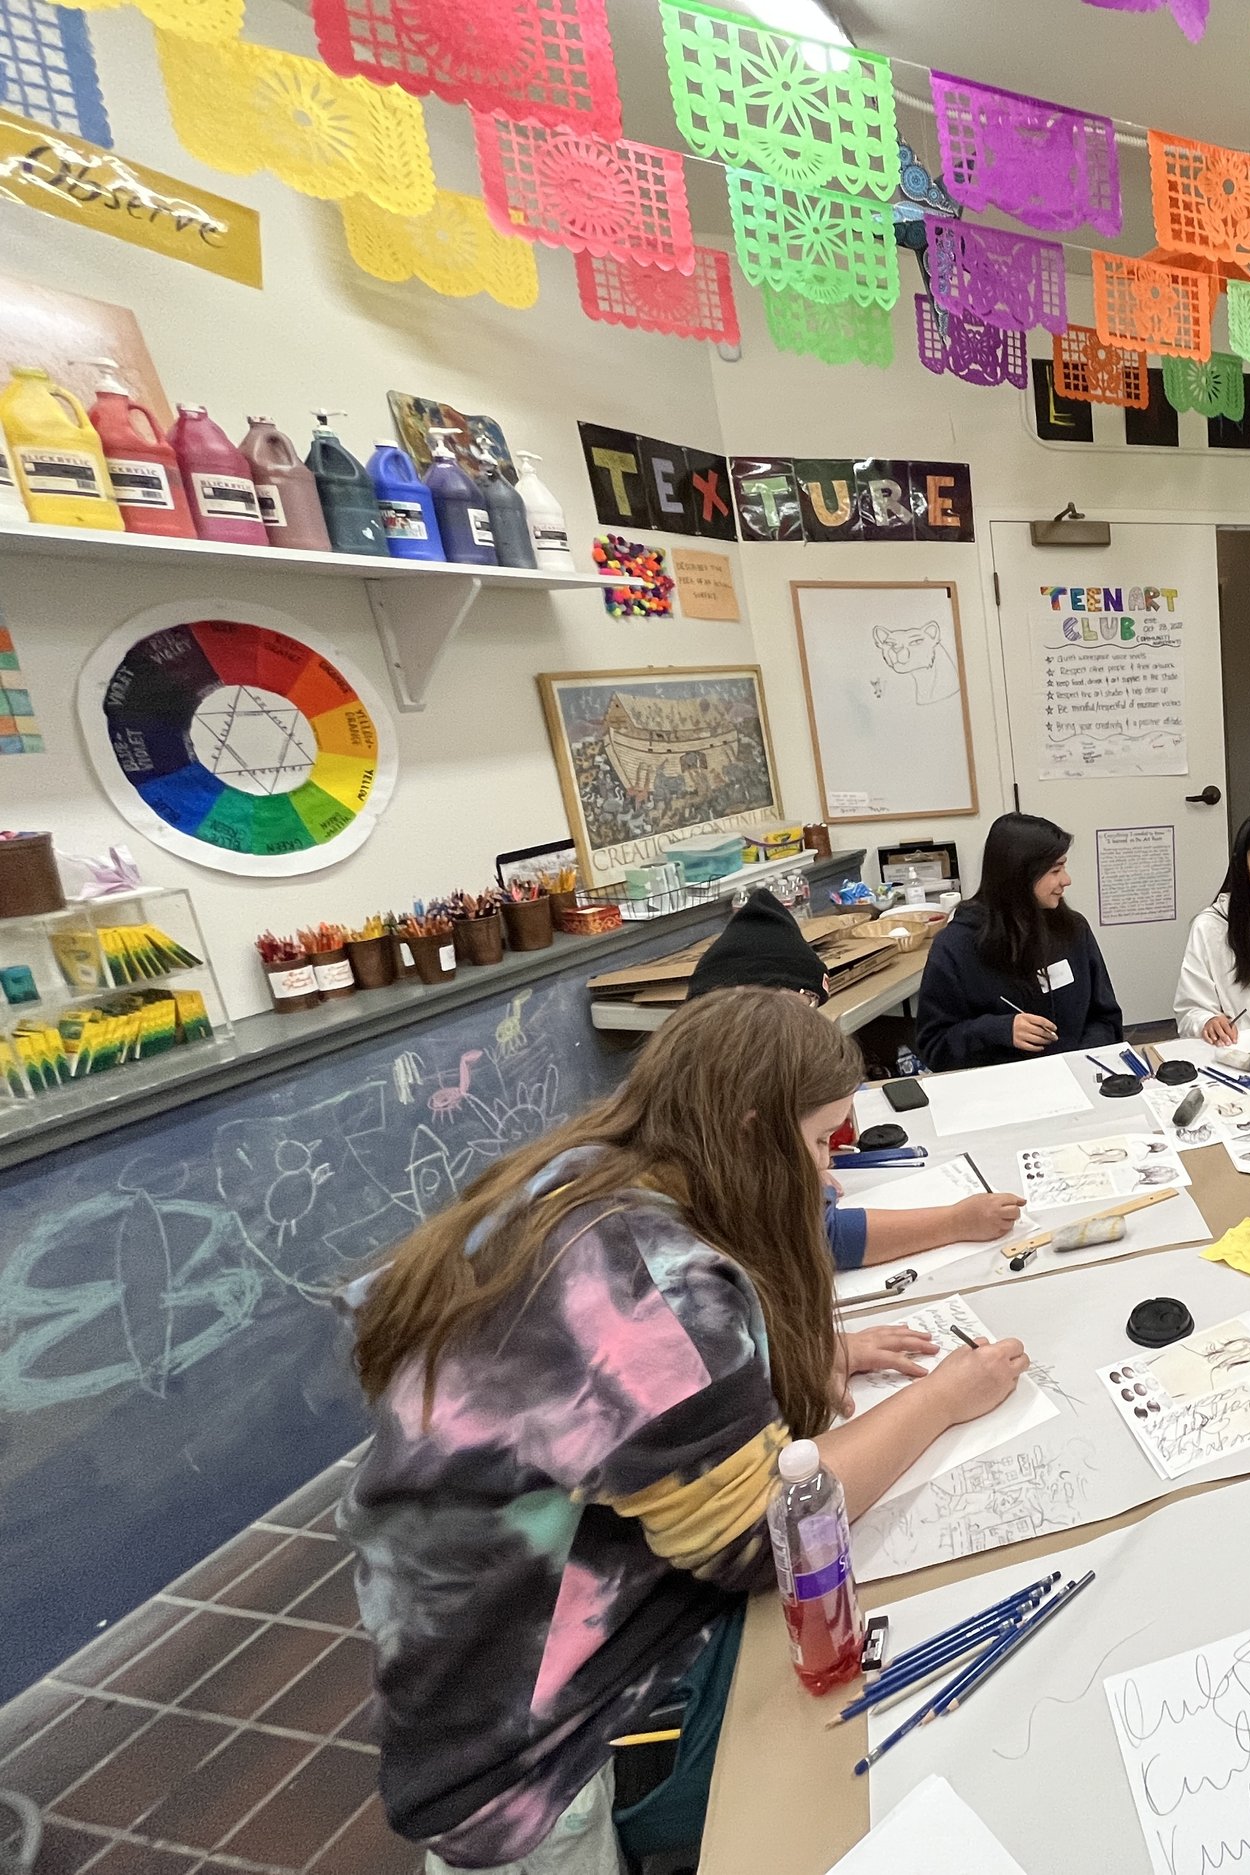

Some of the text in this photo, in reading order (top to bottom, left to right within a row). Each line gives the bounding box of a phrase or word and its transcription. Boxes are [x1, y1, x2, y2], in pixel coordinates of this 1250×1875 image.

[21, 145, 229, 249] Observe
[591, 447, 961, 528] TEXTURE
[1040, 586, 1178, 612] TEEN ART
[1063, 616, 1136, 641] CLUB
[358, 769, 374, 802] YELLOW
[266, 838, 303, 853] GREEN
[592, 829, 685, 871] CREATION
